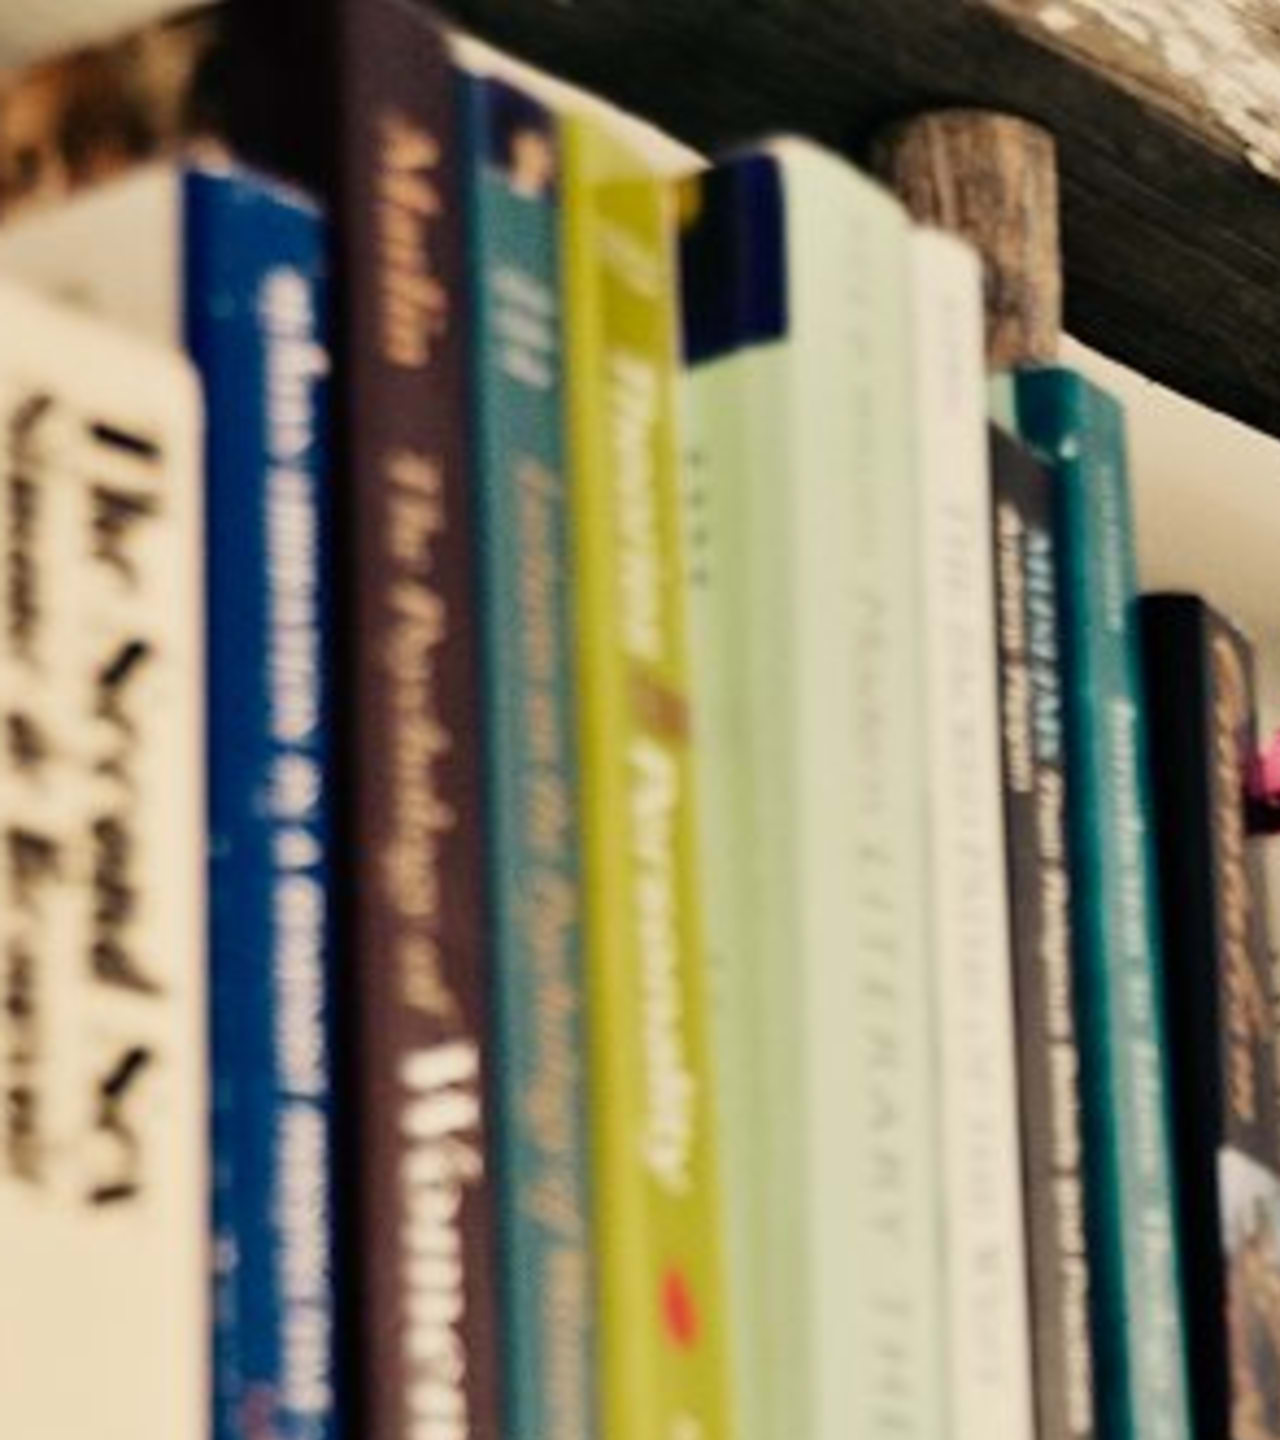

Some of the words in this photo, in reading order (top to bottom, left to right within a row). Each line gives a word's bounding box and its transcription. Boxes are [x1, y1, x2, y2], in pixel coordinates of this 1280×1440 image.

[88, 424, 166, 592] The
[1024, 530, 1060, 763] MUSLIMS
[92, 638, 170, 996] Second
[373, 583, 458, 916] Psychology
[1109, 699, 1142, 956] Introduction
[624, 743, 702, 1192] Personality
[1040, 868, 1070, 1039] Religious
[1049, 1044, 1082, 1169] Beliefs
[1055, 1176, 1085, 1252] and
[1060, 1256, 1093, 1434] Practices
